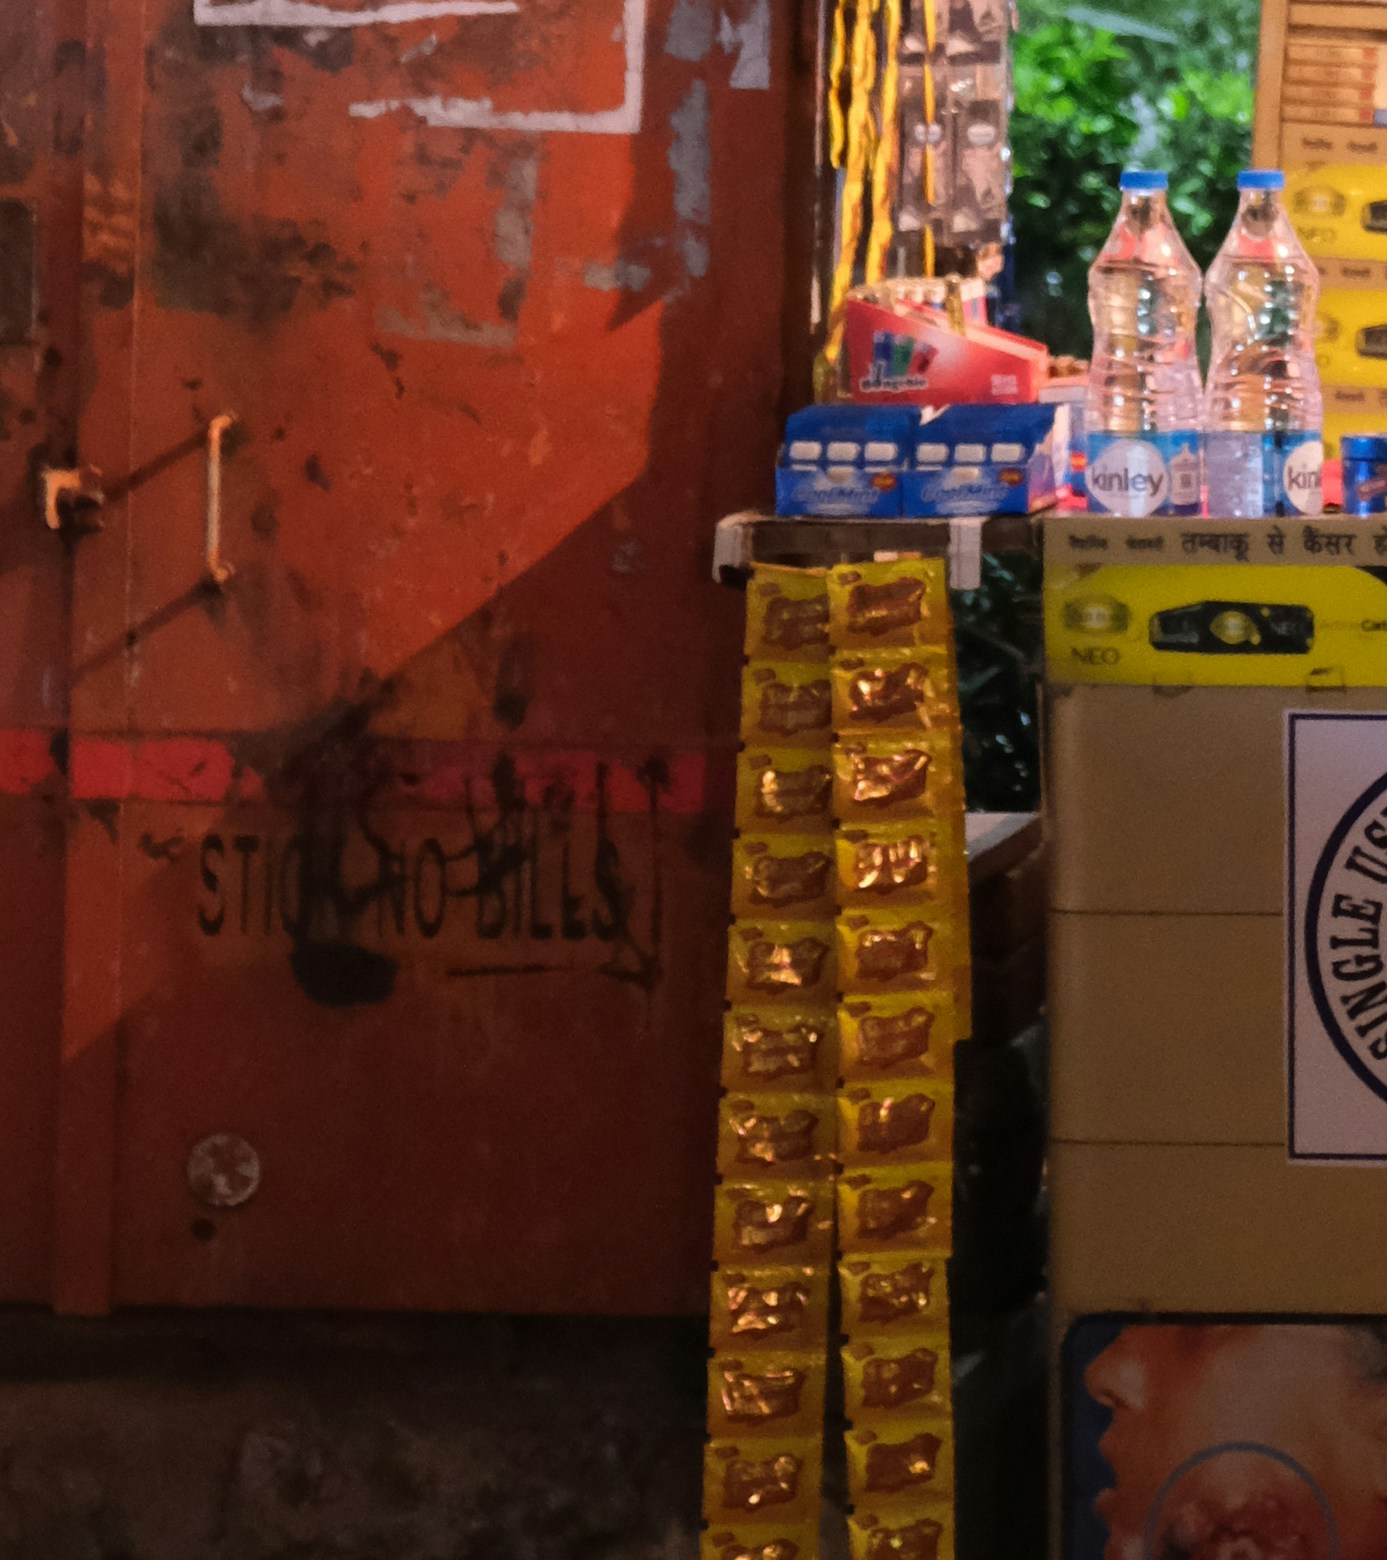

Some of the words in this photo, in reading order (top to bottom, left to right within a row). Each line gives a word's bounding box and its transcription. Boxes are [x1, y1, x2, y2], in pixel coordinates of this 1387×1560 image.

[1091, 463, 1164, 496] kinley
[1181, 530, 1250, 562] तम्बाकू
[1266, 525, 1285, 556] से
[1302, 525, 1355, 556] कैंसर
[1071, 647, 1120, 666] NEO
